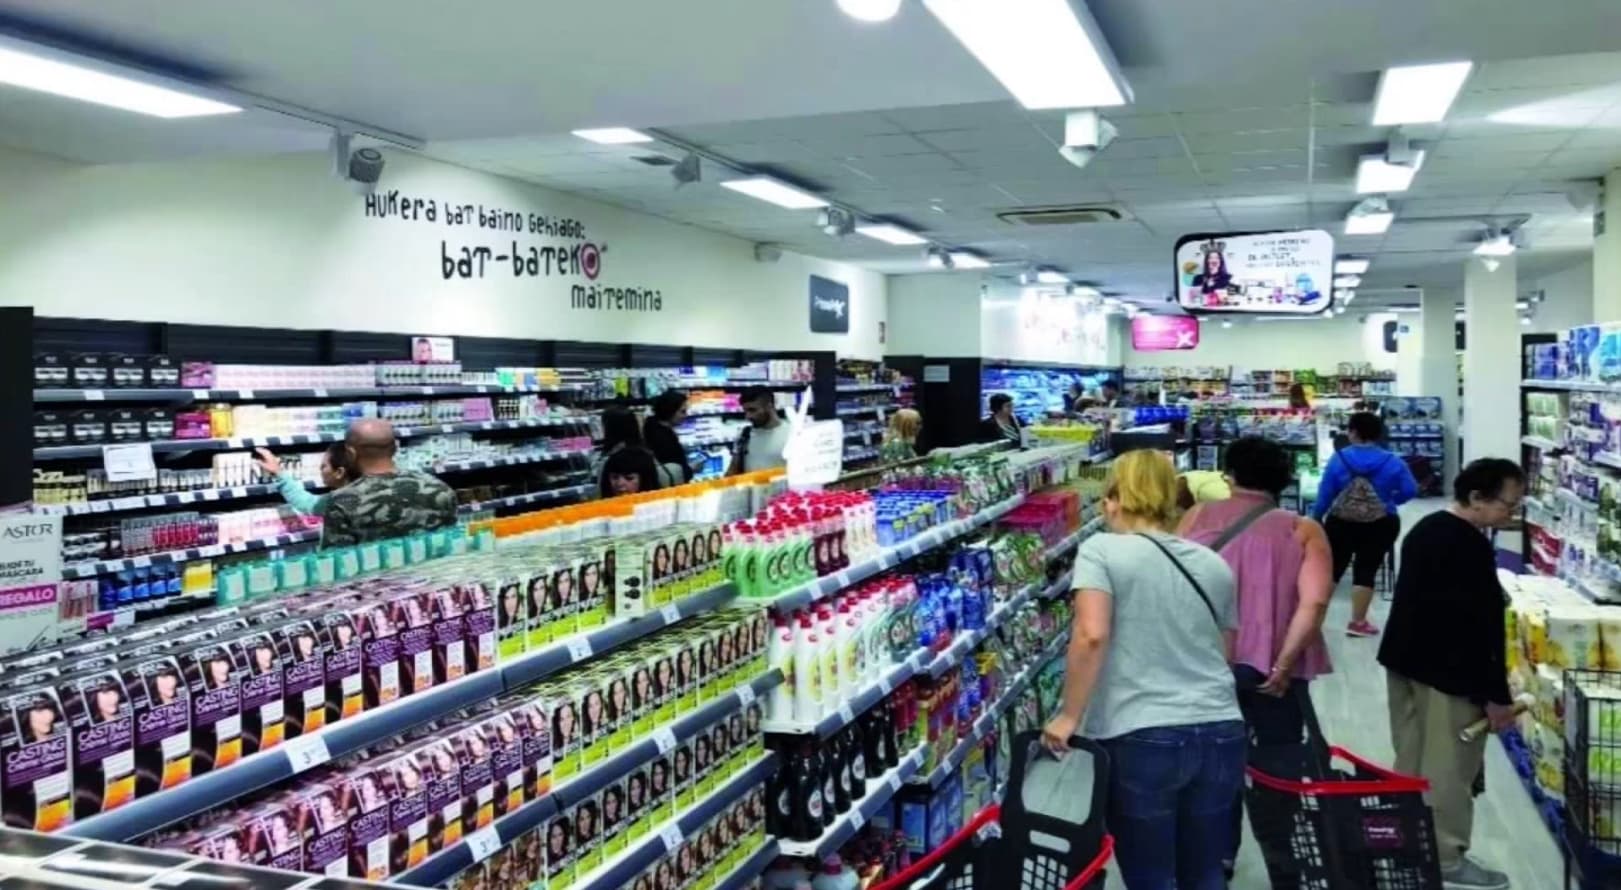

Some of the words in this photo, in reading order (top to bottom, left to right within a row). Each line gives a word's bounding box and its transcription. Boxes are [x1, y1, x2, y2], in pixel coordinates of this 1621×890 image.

[3, 523, 53, 539] ASTOR
[195, 687, 238, 707] CASTING
[138, 702, 185, 724] CASTING
[78, 718, 130, 744] CASTING
[7, 738, 64, 763] CASTING
[308, 826, 345, 852] CASTING
